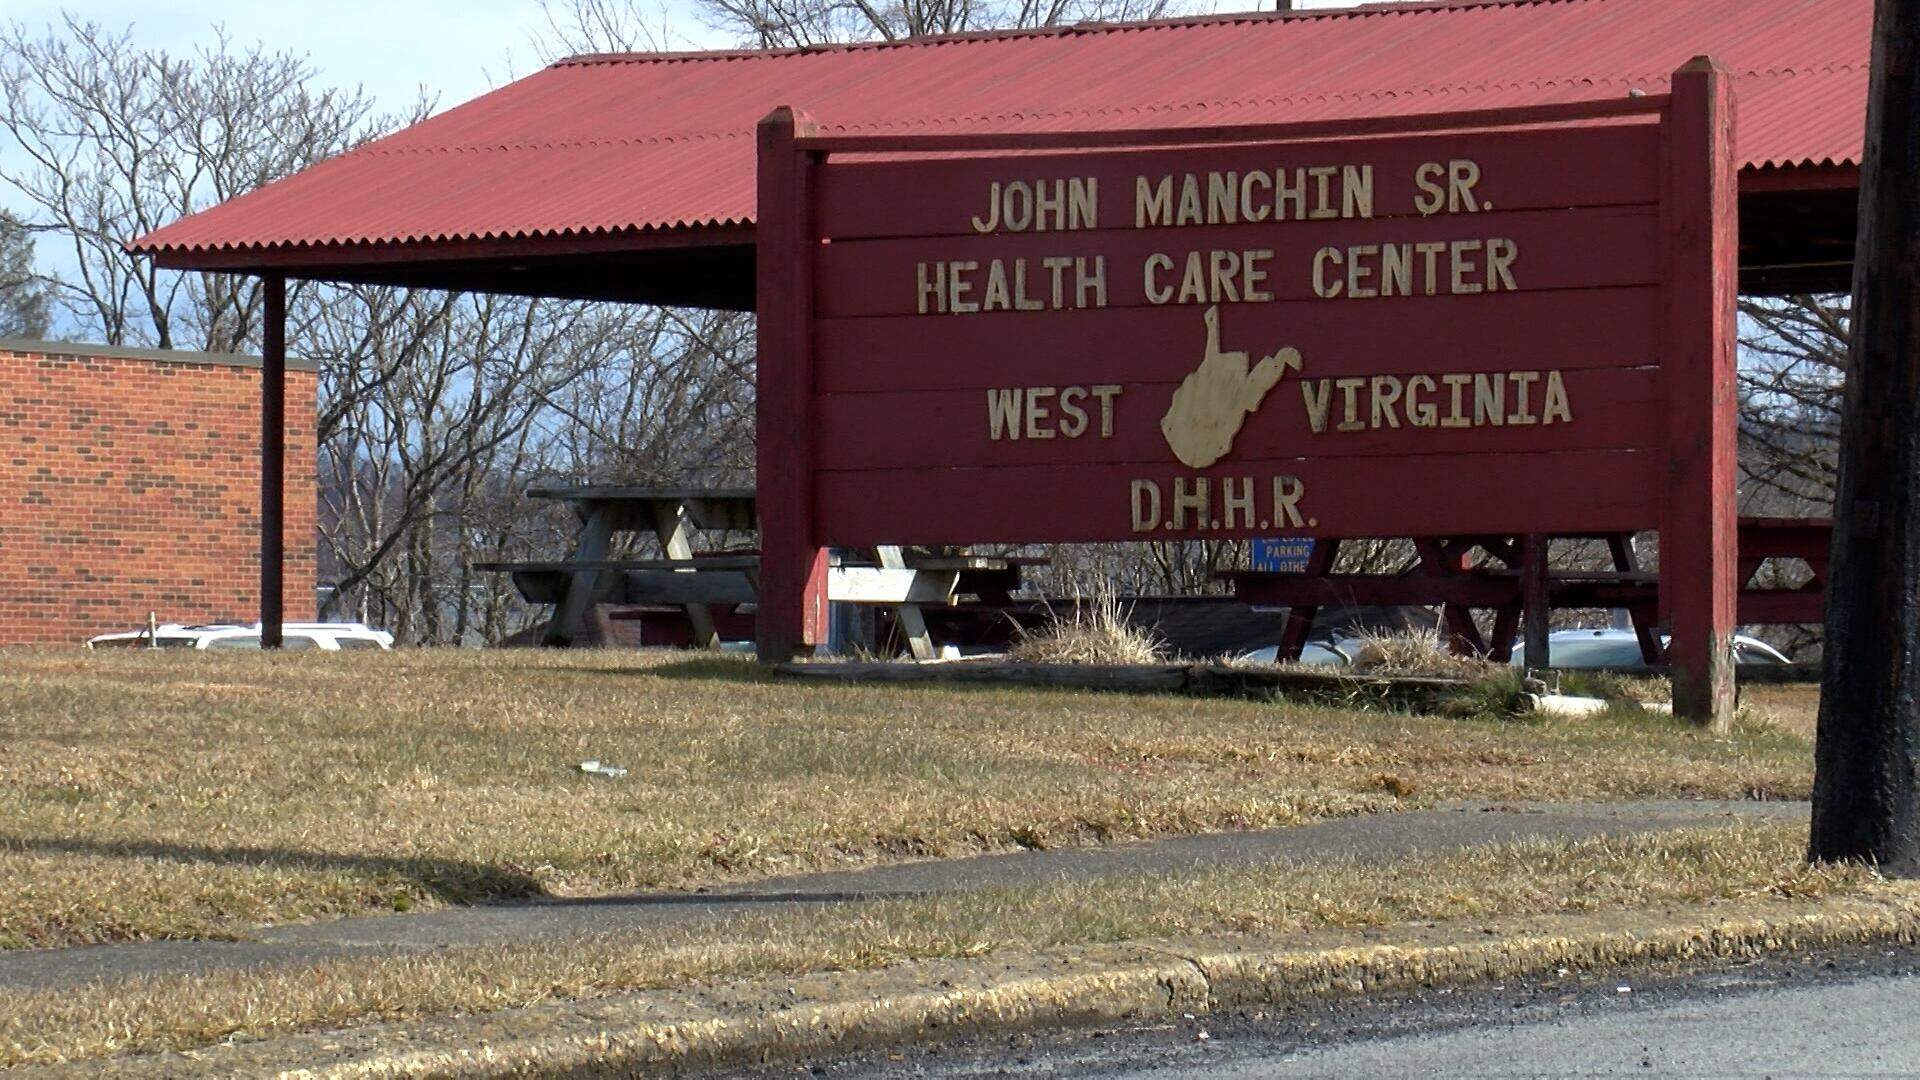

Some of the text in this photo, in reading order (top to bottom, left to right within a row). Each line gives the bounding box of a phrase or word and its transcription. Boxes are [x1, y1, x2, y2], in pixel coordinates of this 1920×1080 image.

[971, 159, 1493, 233] JOHN MANCHIN SR.
[916, 238, 1519, 314] HEALTH CARE CENTER
[986, 370, 1572, 441] WEST VIRGINIA
[1130, 477, 1318, 532] D.H.H.R.
[1266, 545, 1310, 558] PARKING
[1279, 560, 1309, 573] OTHE
